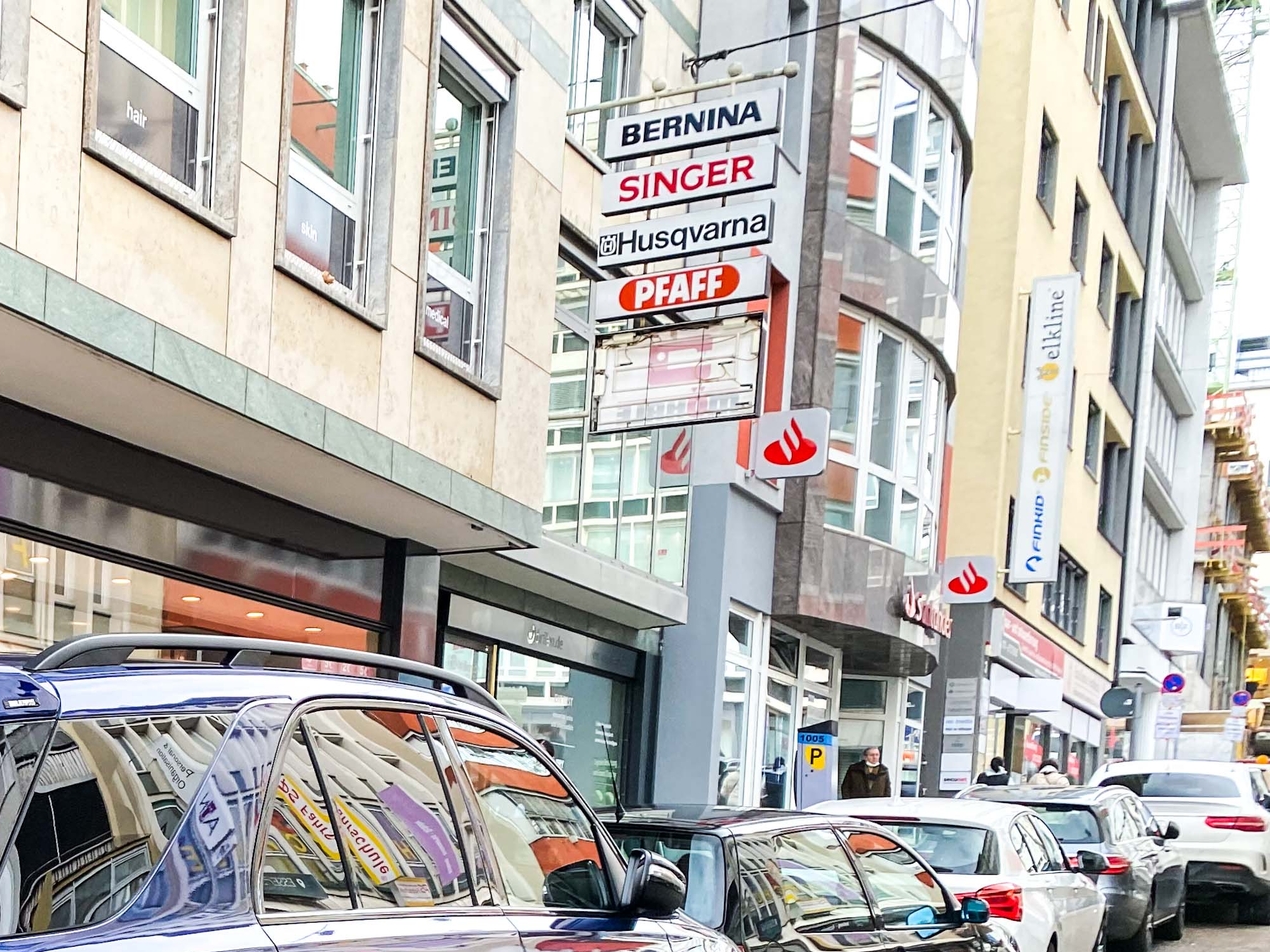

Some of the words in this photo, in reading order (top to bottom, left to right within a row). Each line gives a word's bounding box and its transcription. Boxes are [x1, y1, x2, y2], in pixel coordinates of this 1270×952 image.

[126, 100, 148, 129] hair
[621, 100, 762, 147] BERNINA
[619, 155, 755, 203] SINGER
[617, 213, 767, 256] Husqvarna
[634, 267, 724, 310] PFAFF
[1041, 289, 1065, 360] elkline
[1032, 494, 1045, 552] FINKID
[800, 734, 825, 743] 1005
[811, 748, 823, 765] P
